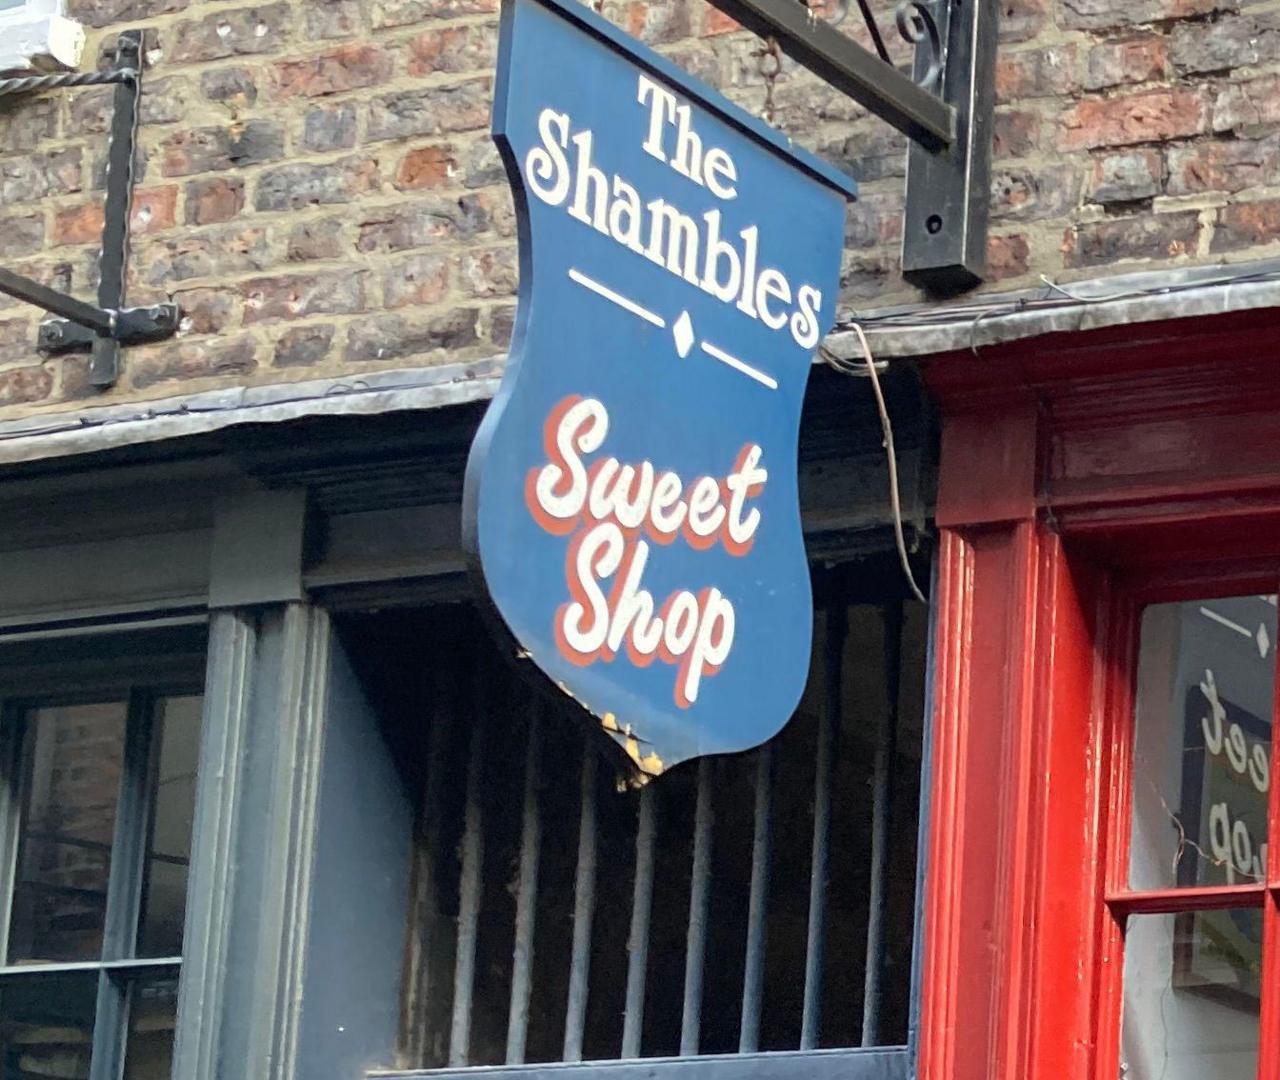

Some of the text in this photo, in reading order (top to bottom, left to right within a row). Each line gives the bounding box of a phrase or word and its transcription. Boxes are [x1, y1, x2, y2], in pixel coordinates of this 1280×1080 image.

[637, 74, 737, 200] The
[526, 108, 821, 350] Shambles
[528, 396, 767, 552] Sweet
[558, 523, 736, 705] Shop
